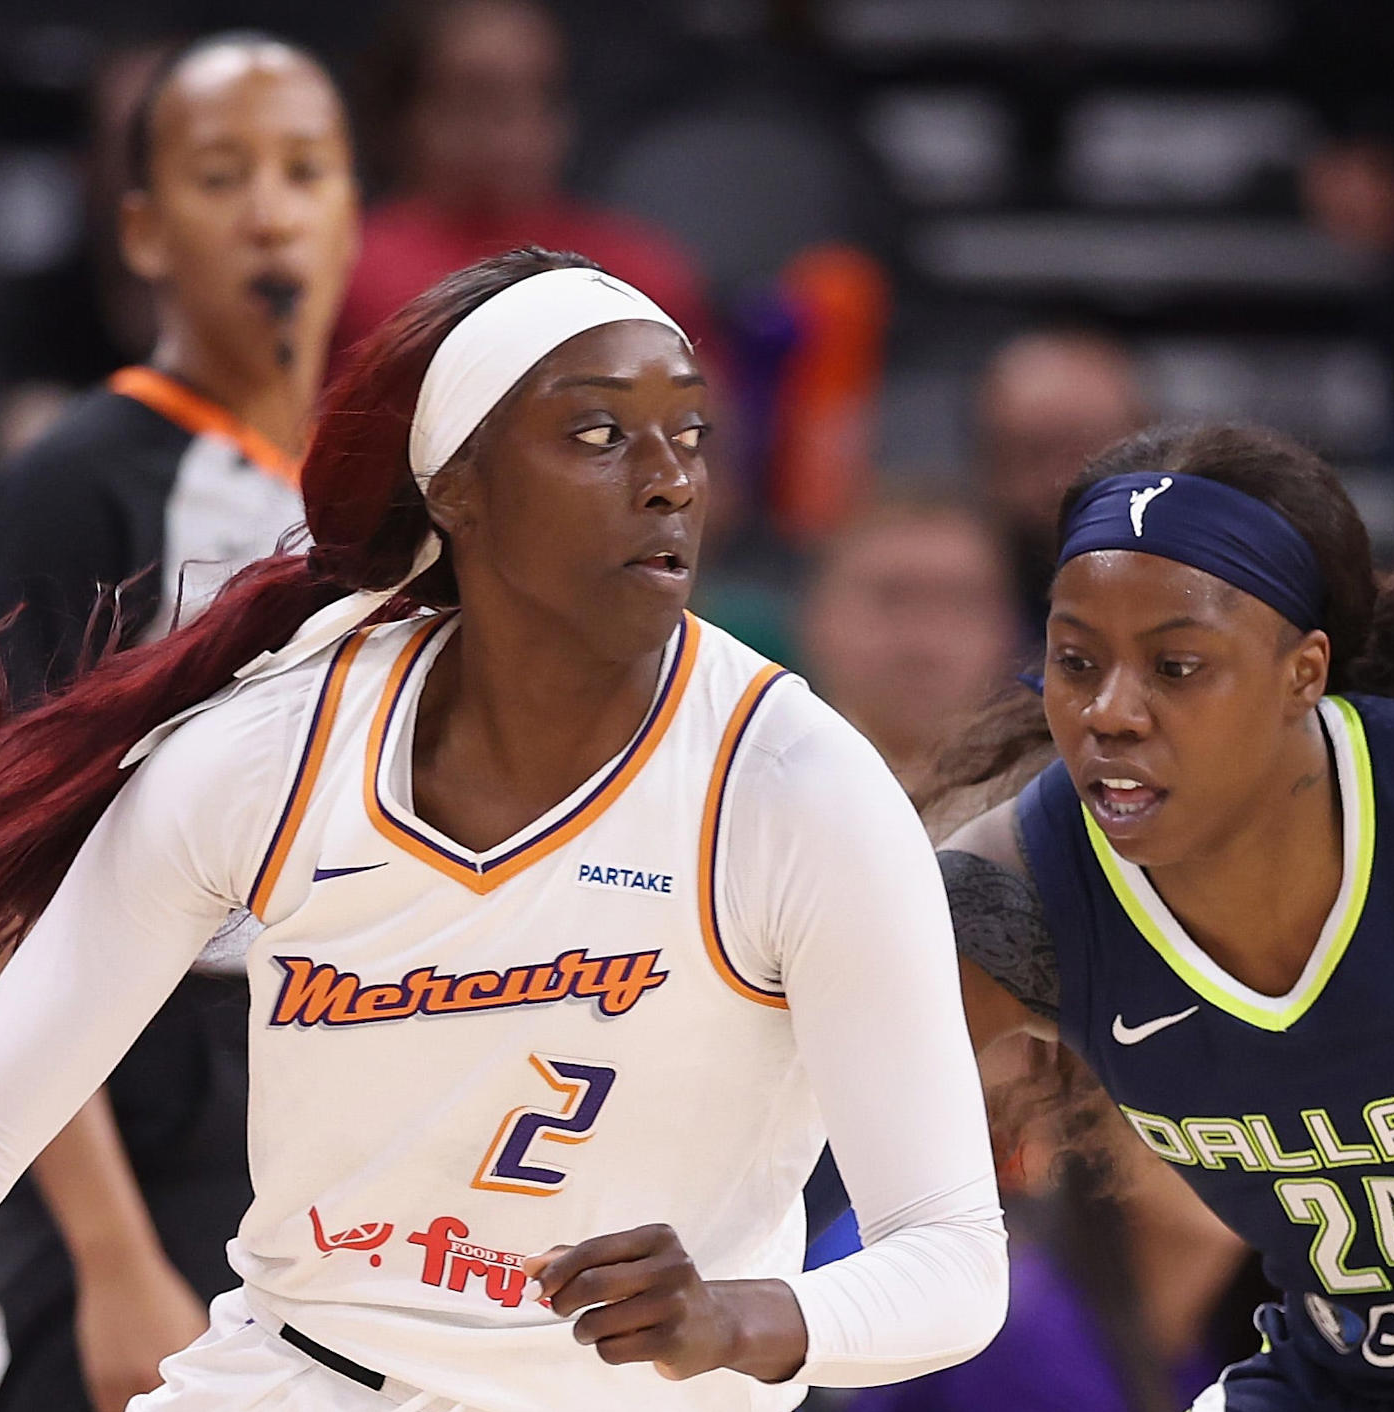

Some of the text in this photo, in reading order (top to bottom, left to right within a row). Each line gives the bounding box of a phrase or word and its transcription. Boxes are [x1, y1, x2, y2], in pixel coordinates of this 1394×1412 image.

[578, 864, 673, 893] PARTAKE
[269, 948, 669, 1029] Mercury
[471, 1052, 616, 1197] 2
[406, 1216, 552, 1308] fry
[450, 1241, 525, 1266] FOOD ST
